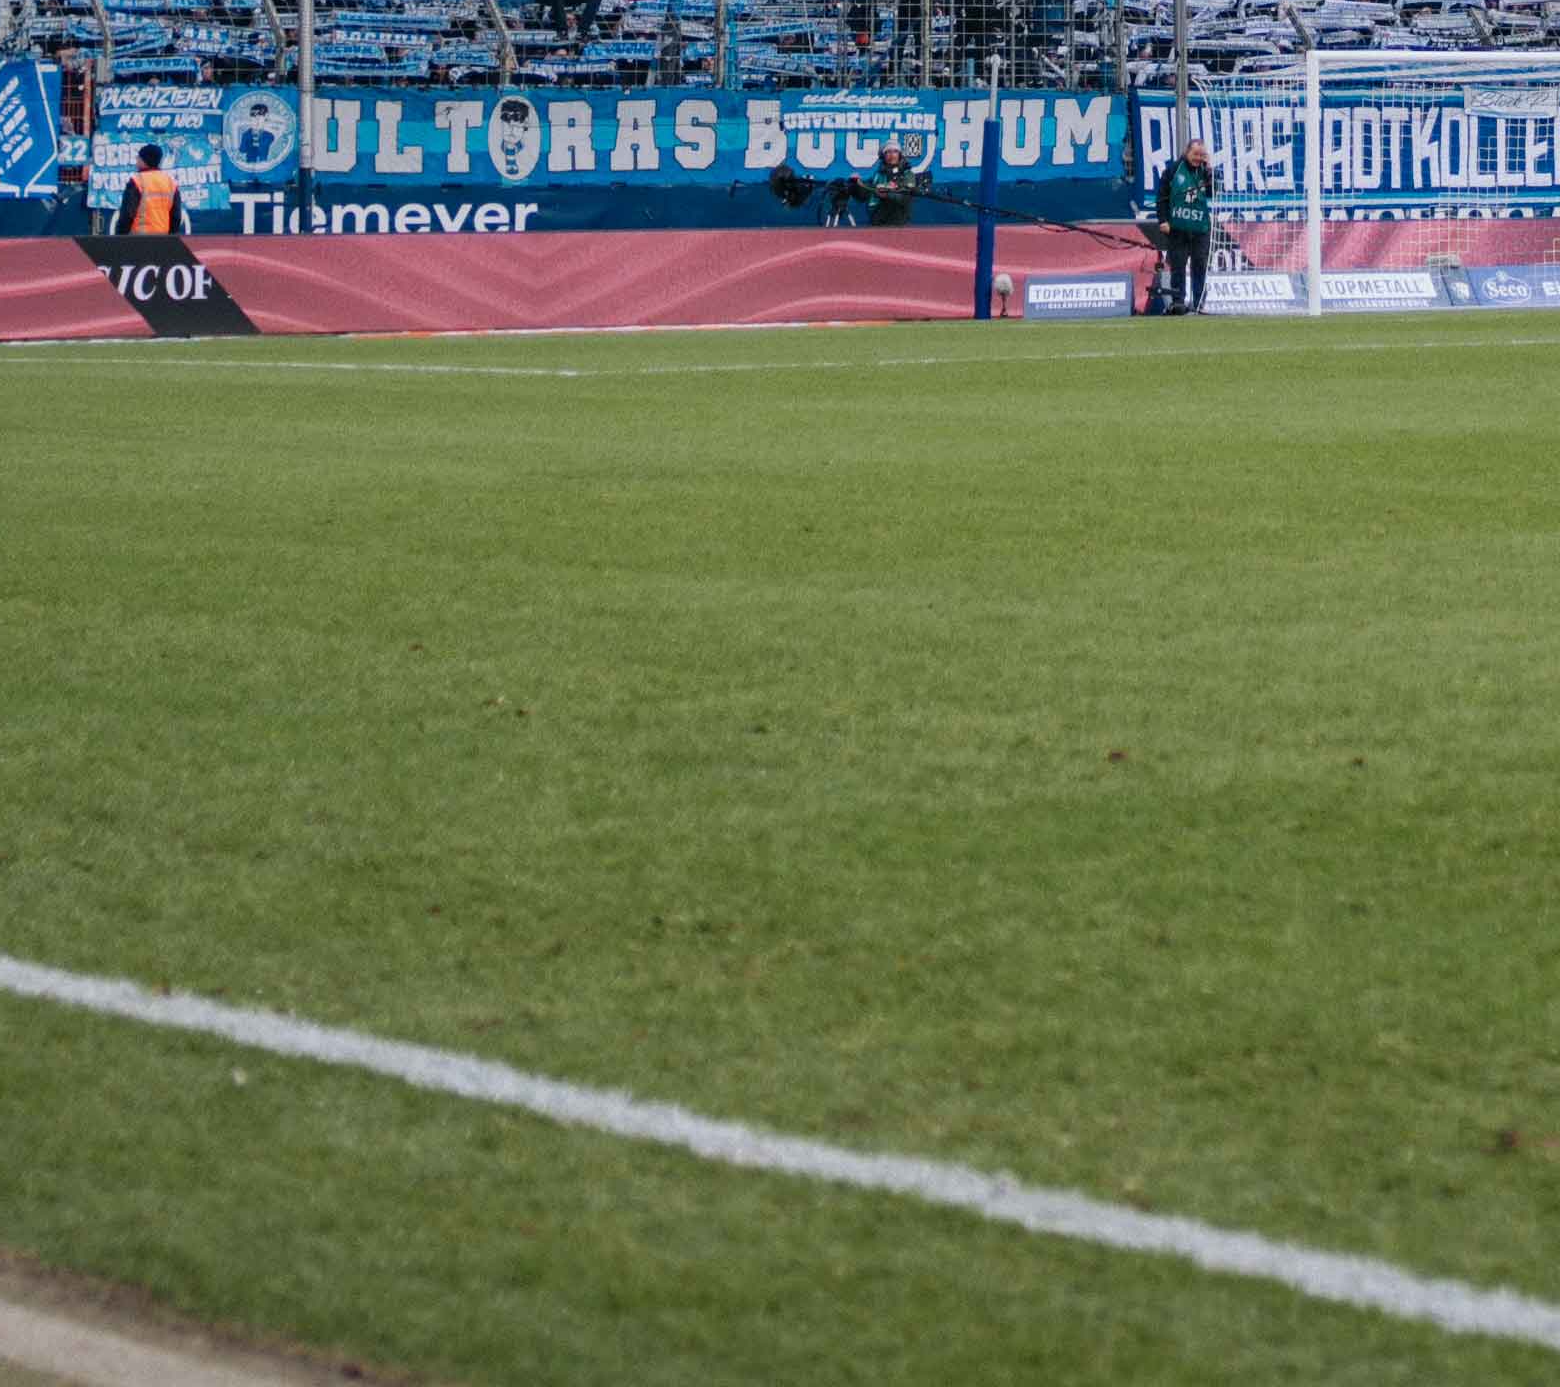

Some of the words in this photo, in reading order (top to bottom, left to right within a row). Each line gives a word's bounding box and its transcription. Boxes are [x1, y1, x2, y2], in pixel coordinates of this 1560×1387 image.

[58, 137, 88, 163] 22
[1034, 287, 1118, 301] TOPMETALL
[1205, 280, 1284, 299] PMETALL
[1323, 280, 1425, 298] TOPMETALL
[1487, 279, 1529, 301] Seco
